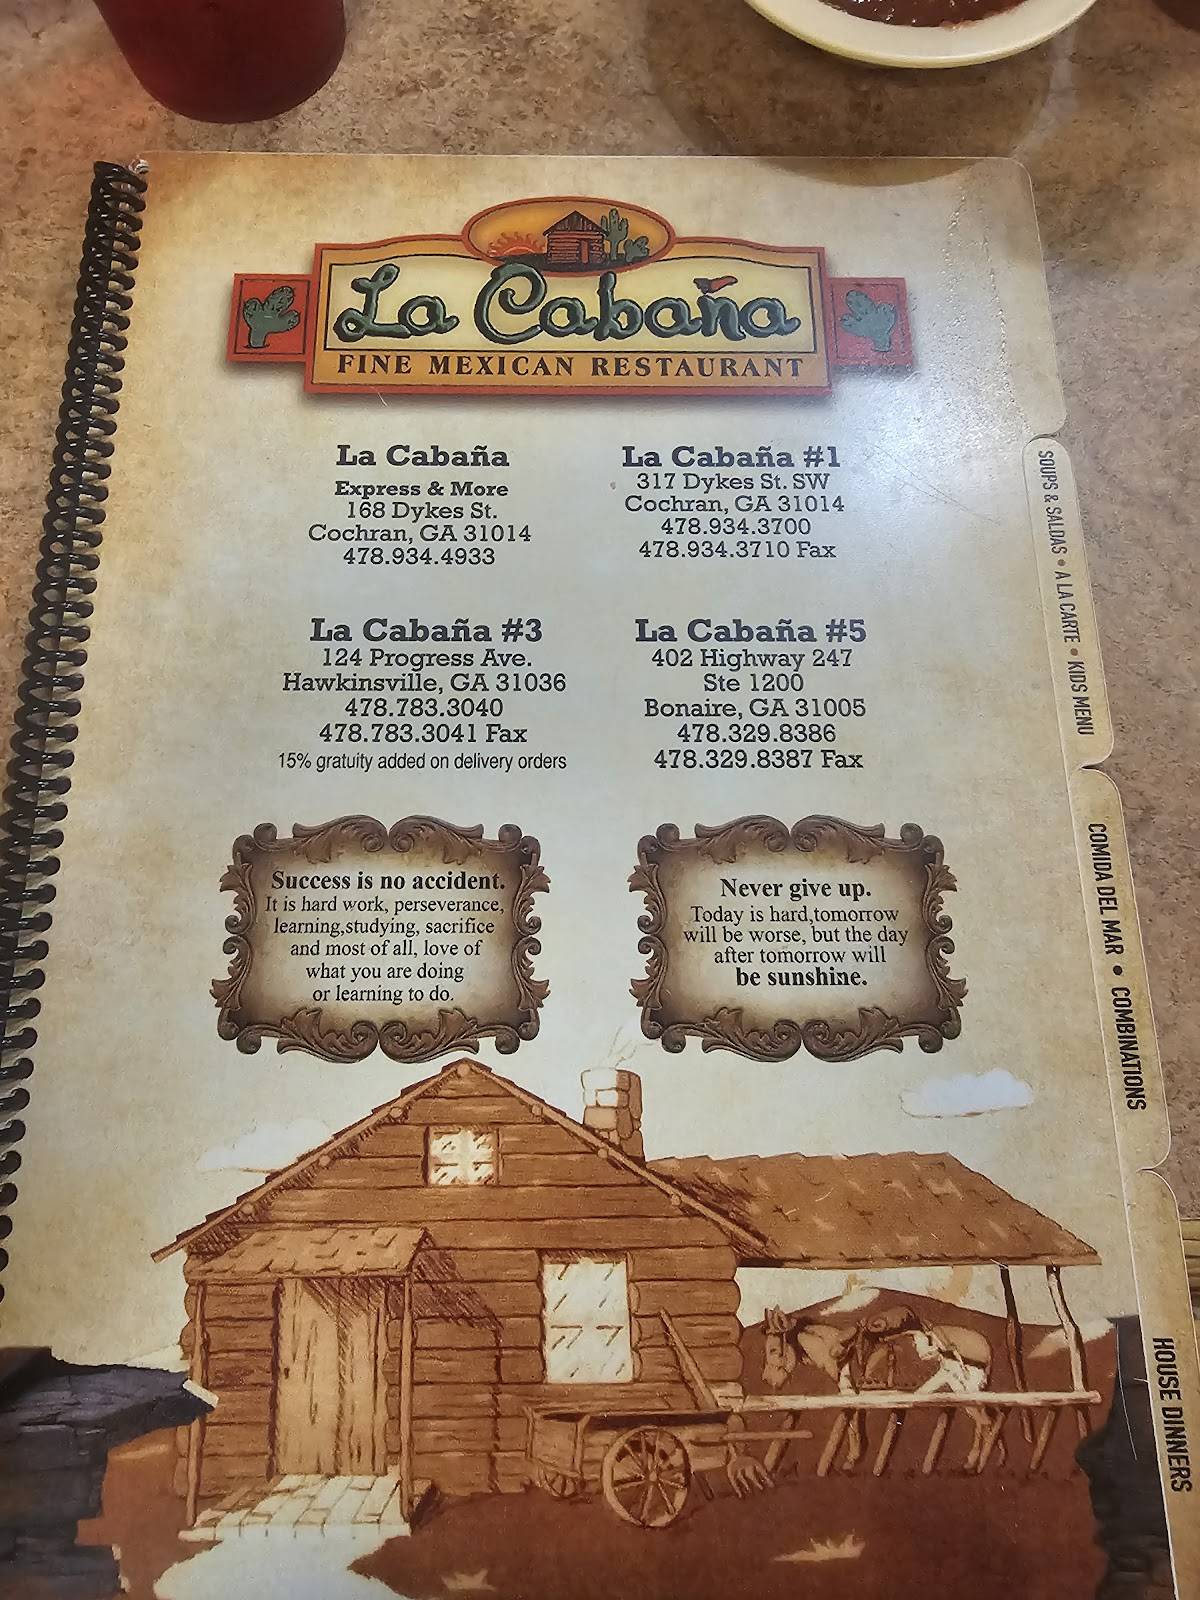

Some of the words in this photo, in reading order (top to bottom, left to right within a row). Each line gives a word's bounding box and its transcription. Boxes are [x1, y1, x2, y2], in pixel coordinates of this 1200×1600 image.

[332, 263, 458, 343] La
[473, 263, 801, 345] Cabaña
[337, 354, 413, 376] FINE
[429, 356, 576, 377] MEXICAN
[592, 357, 804, 378] RESTAURANT
[336, 445, 376, 466] La
[387, 445, 509, 466] Cabaña
[622, 446, 662, 467] La
[672, 446, 795, 467] Cabaña
[803, 446, 840, 467] #1
[1038, 451, 1058, 489] SOUPS
[335, 481, 420, 499] Express
[427, 481, 444, 496] &
[451, 482, 508, 496] More
[637, 473, 675, 489] 317
[683, 473, 754, 494] Dykes
[761, 473, 787, 489] St.
[793, 473, 830, 489] SW
[348, 502, 385, 518] 168
[392, 502, 463, 523] Dykes
[471, 502, 497, 519] St.
[625, 495, 728, 514] Cochran,
[735, 495, 772, 512] GA
[778, 496, 844, 512] 31014
[309, 524, 412, 544] Cochran,
[420, 525, 457, 541] GA
[464, 525, 531, 541] 31014
[661, 518, 810, 534] 478.934.3700
[1046, 507, 1067, 554] SALDAS
[344, 547, 495, 565] 478.934.4933
[639, 541, 789, 557] 478.934.3710
[796, 541, 836, 558] Fax
[1055, 571, 1071, 579] A
[1057, 584, 1073, 599] LA
[310, 618, 352, 641] La
[363, 618, 492, 642] Cabaña
[502, 618, 542, 642] #3
[635, 619, 677, 642] La
[688, 619, 817, 642] Cabaña
[826, 619, 866, 642] #5
[1060, 603, 1080, 642] CARTE
[323, 648, 362, 666] 124
[369, 649, 473, 672] Progress
[480, 649, 531, 666] Ave.
[652, 649, 692, 666] 402
[700, 649, 805, 672] Highway
[813, 649, 852, 666] 247
[283, 673, 443, 694] Hawkinsville,
[451, 673, 489, 691] GA
[496, 673, 566, 691] 31036
[704, 673, 740, 691] Ste
[750, 673, 803, 691] 1200
[1068, 662, 1088, 692] KIDS
[345, 698, 503, 717] 478.783.3040
[645, 699, 742, 720] Bonaire,
[750, 698, 789, 716] GA
[796, 698, 865, 717] 31005
[1073, 697, 1094, 734] MENU
[320, 723, 476, 742] 478.783.3041
[486, 724, 527, 742] Fax
[677, 724, 836, 742] 478.329.8386
[279, 753, 311, 768] 15%
[317, 753, 373, 772] gratuity
[378, 753, 425, 768] added
[431, 756, 448, 769] on
[454, 753, 513, 772] delivery
[518, 753, 566, 769] orders
[654, 749, 812, 768] 478.329.8387
[821, 750, 863, 768] Fax
[1088, 824, 1113, 881] COMIDA
[272, 871, 350, 889] Success
[358, 872, 372, 889] is
[381, 876, 405, 889] no
[413, 871, 504, 889] accident.
[720, 879, 783, 897] Never
[790, 879, 831, 901] give
[838, 884, 871, 901] up.
[266, 897, 277, 911] It
[284, 896, 295, 911] is
[301, 896, 336, 911] hard
[343, 896, 388, 913] work,
[394, 902, 503, 915] perseverance,
[1097, 887, 1118, 915] DEL
[426, 917, 494, 933] sacrifice
[691, 906, 744, 926] Today
[751, 905, 763, 922] is
[684, 926, 716, 942] will
[723, 926, 743, 942] be
[749, 931, 806, 945] worse,
[811, 926, 840, 942] but
[845, 926, 872, 942] the
[878, 926, 908, 946] day
[1102, 920, 1124, 954] MAR
[291, 940, 319, 955] and
[326, 943, 365, 955] most
[371, 940, 390, 955] of
[393, 940, 417, 958] all,
[424, 940, 458, 955] love
[464, 940, 483, 955] of
[715, 946, 754, 963] after
[760, 949, 845, 963] tomorrow
[852, 946, 886, 962] will
[306, 963, 345, 978] what
[351, 967, 381, 982] you
[387, 967, 411, 978] are
[417, 962, 463, 982] doing
[736, 967, 760, 986] be
[768, 967, 867, 985] sunshine.
[313, 990, 330, 1001] or
[336, 985, 403, 1005] learning
[409, 988, 424, 1001] to
[430, 985, 453, 1001] do.
[1111, 987, 1146, 1110] COMBINATIONS
[1153, 1338, 1182, 1400] HOUSE
[1162, 1407, 1192, 1491] DINNERS
